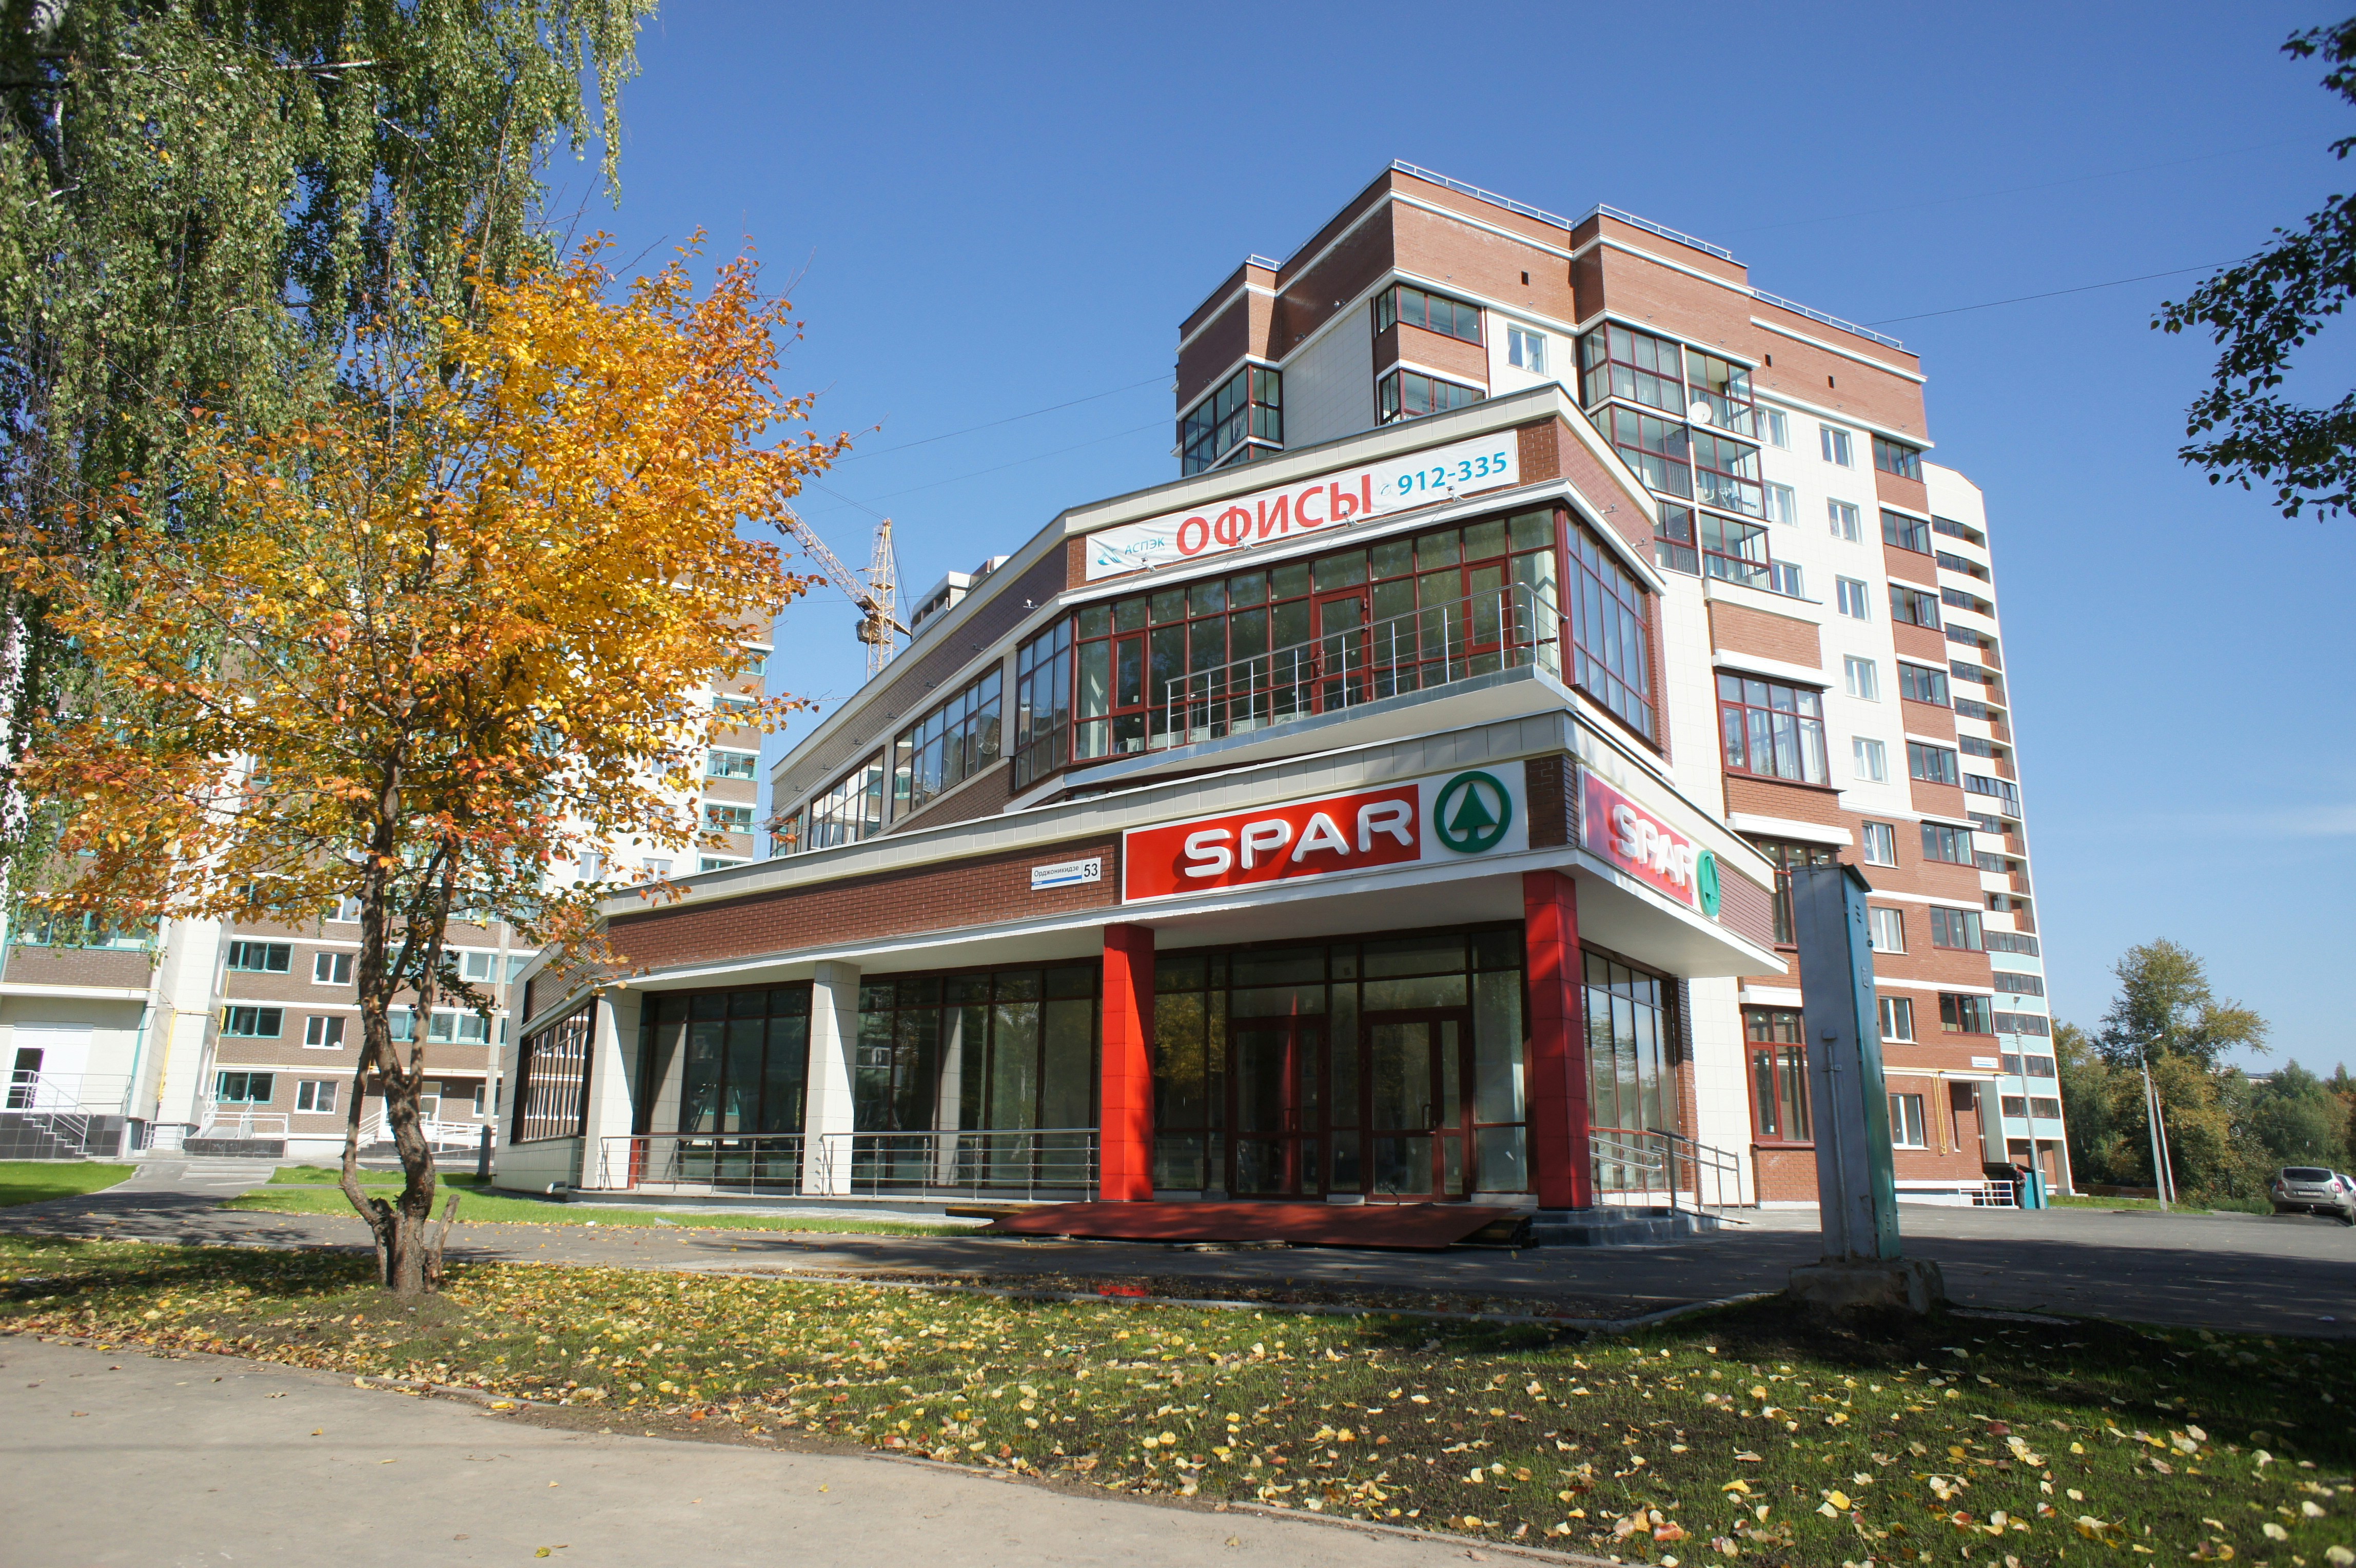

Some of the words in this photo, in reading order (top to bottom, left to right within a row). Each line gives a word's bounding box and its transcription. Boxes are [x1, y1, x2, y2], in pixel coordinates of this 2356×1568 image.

[1176, 473, 1371, 556] ОФИСЫ
[1397, 451, 1507, 496] 912-335
[1125, 537, 1165, 555] АСПЭК
[1034, 865, 1079, 878] Орджоникидзе
[1084, 863, 1098, 877] 53
[1184, 798, 1414, 878] SPAR
[1613, 803, 1695, 894] SPAR
